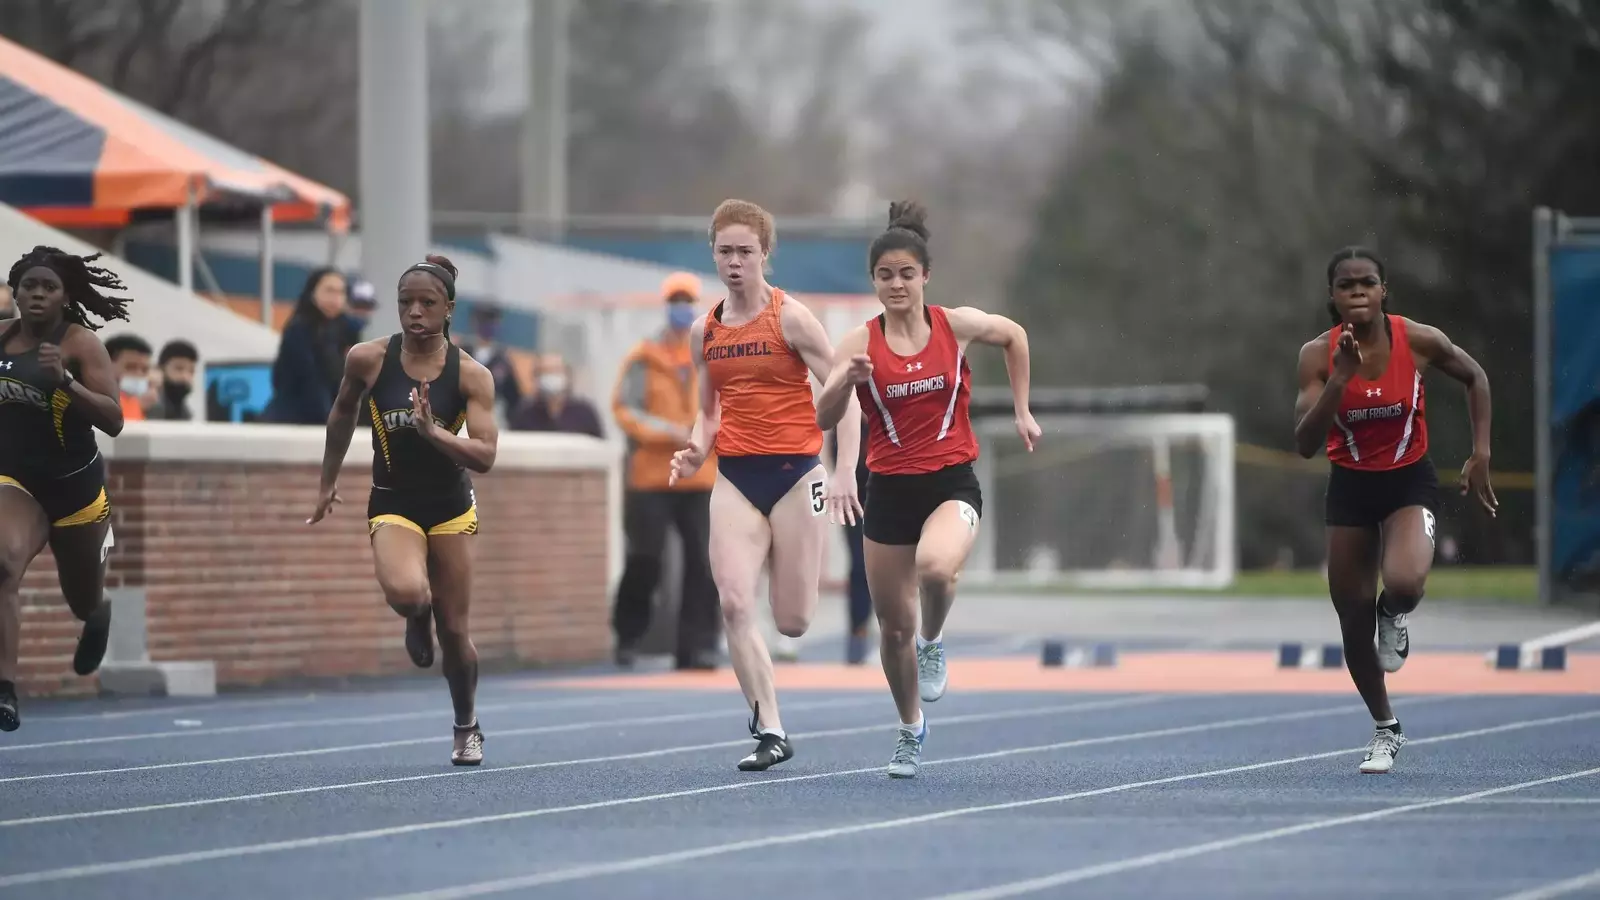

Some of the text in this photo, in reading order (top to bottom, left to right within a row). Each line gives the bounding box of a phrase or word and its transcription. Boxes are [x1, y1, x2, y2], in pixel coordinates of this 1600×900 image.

[706, 342, 772, 360] BUCKNELL
[886, 375, 944, 398] SAINT FRANCIS
[1347, 402, 1402, 423] SAINT FRANCIS
[811, 481, 825, 513] 5
